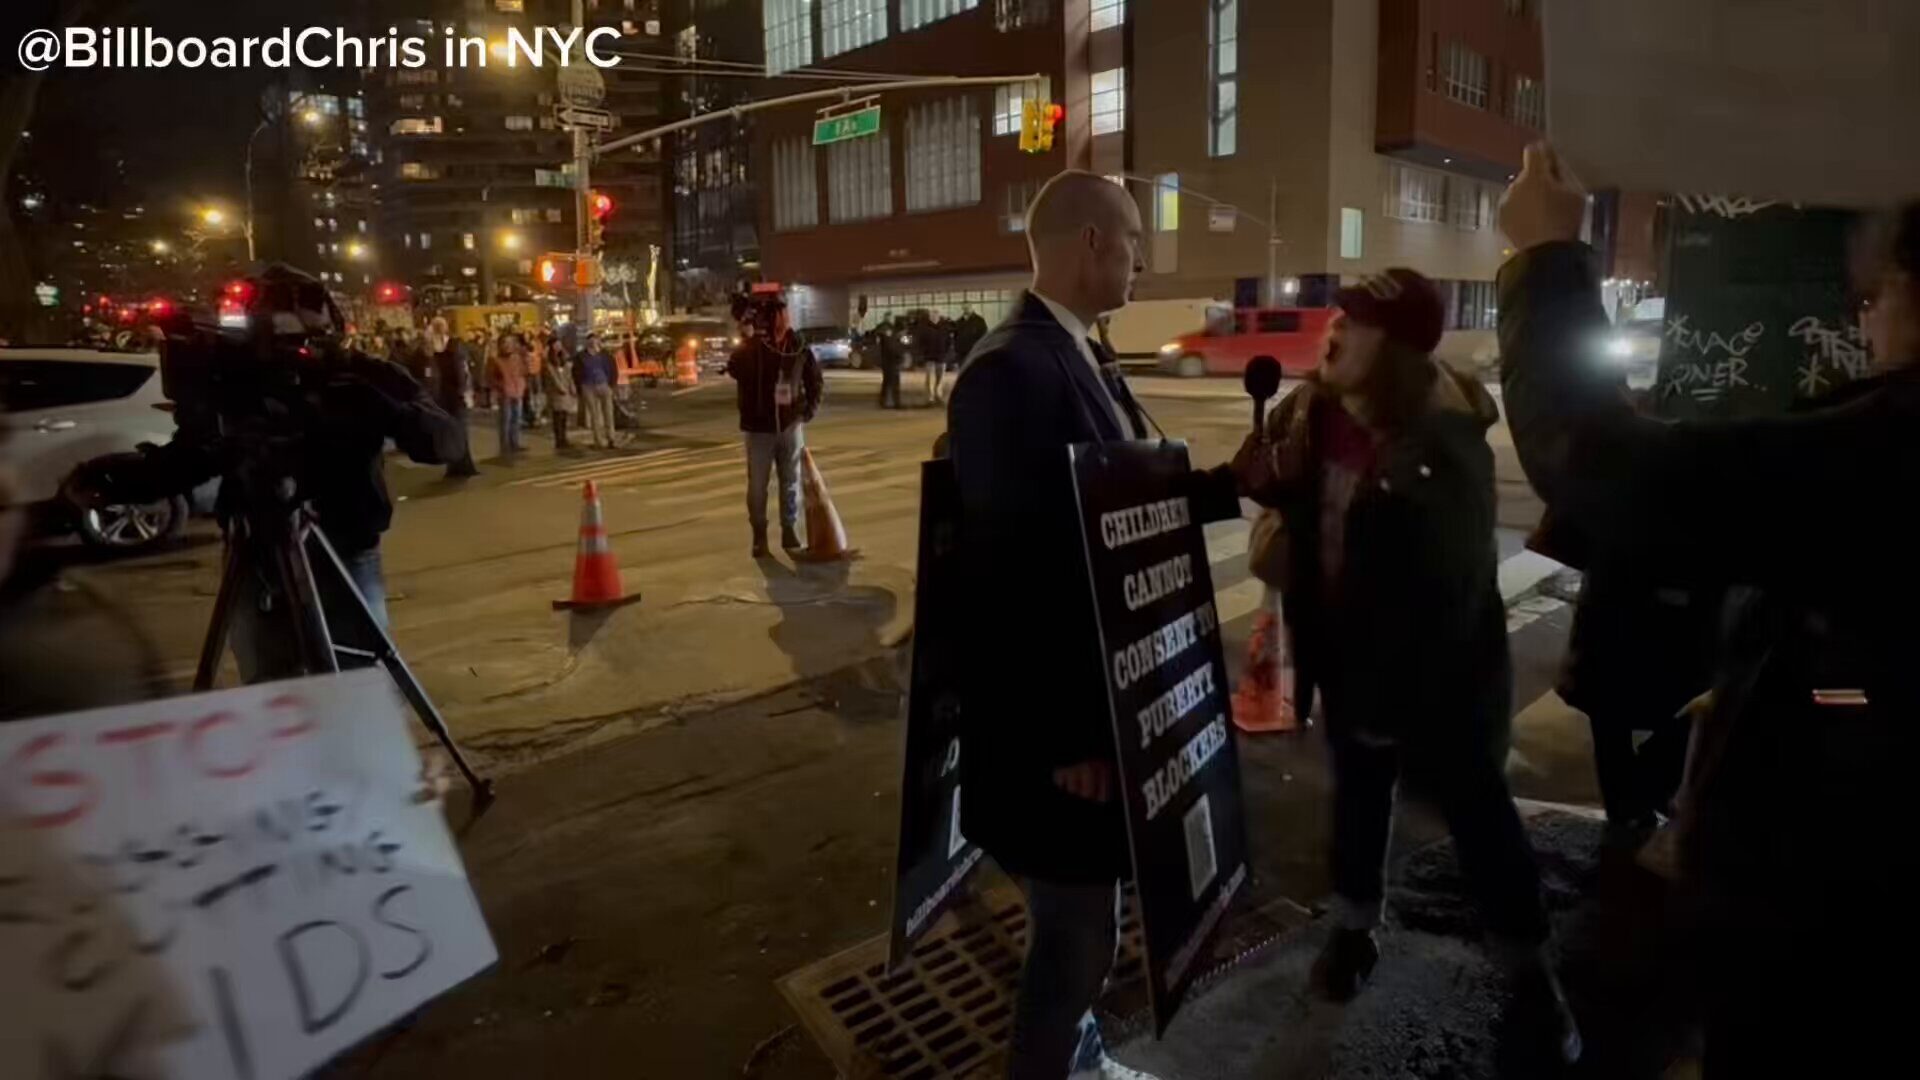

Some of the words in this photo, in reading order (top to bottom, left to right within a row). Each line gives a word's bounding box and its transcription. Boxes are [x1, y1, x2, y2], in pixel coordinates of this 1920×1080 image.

[1100, 496, 1191, 549] CHILDREN
[1123, 553, 1193, 611] CANNOT
[1113, 611, 1197, 690] CONSENT
[1137, 661, 1216, 749] PUBERTY
[4, 694, 317, 829] STOP
[1142, 713, 1226, 820] BLOCKERS
